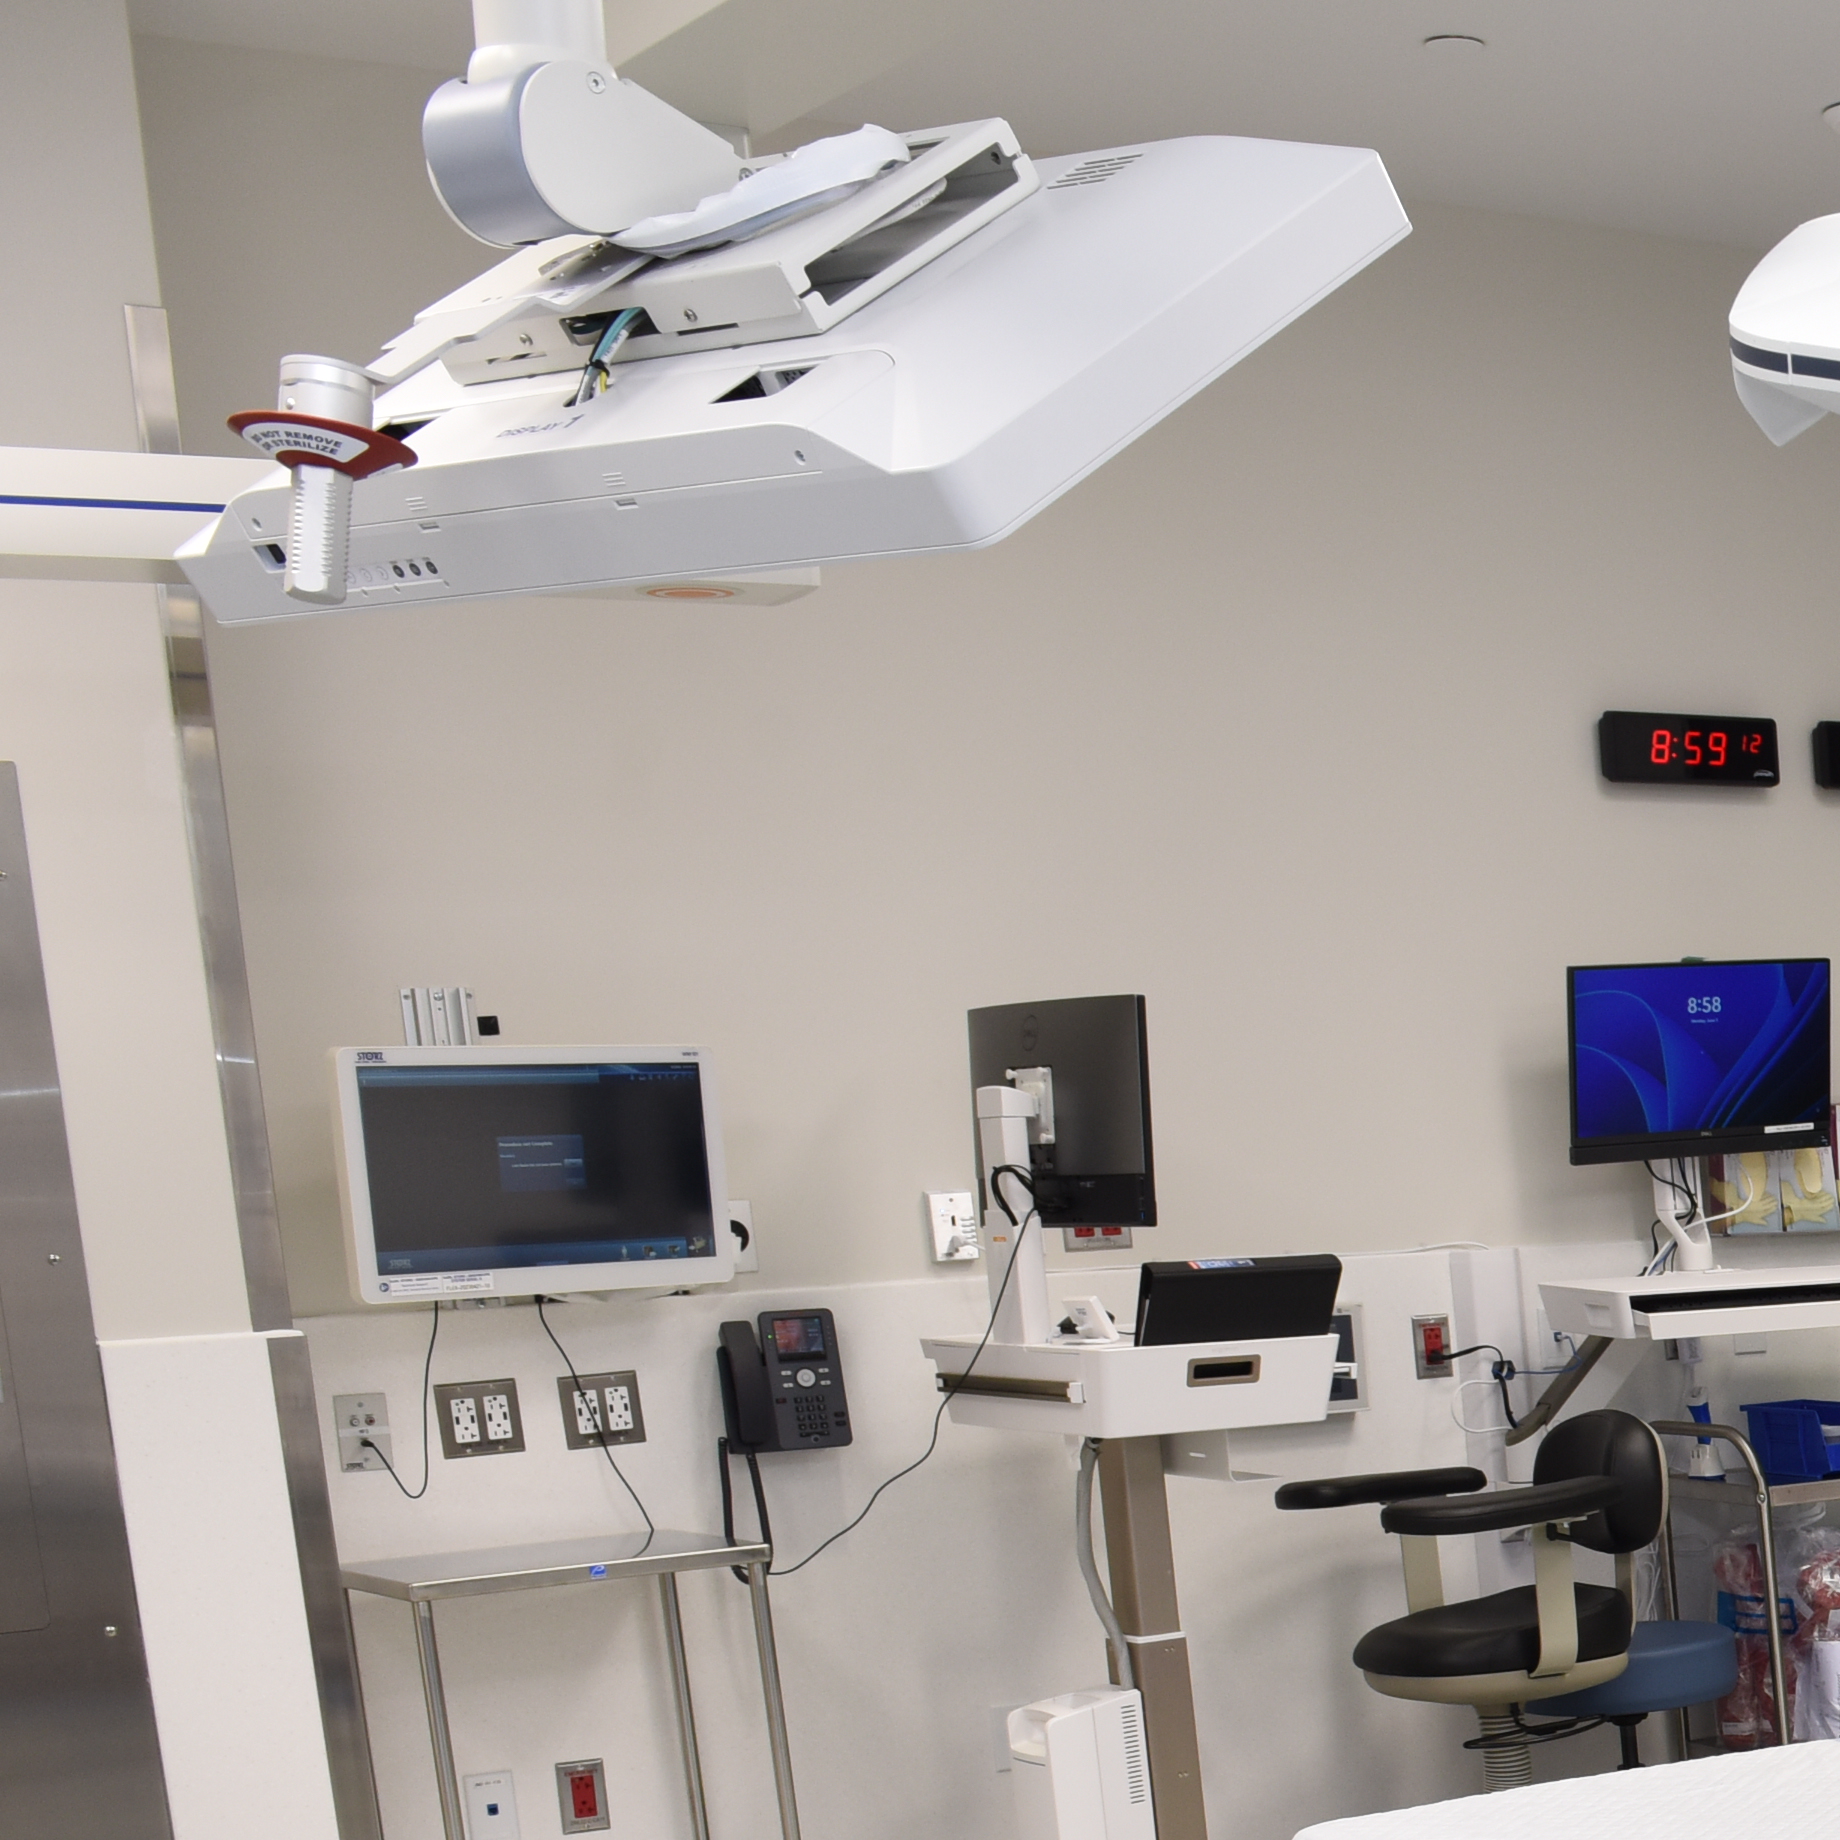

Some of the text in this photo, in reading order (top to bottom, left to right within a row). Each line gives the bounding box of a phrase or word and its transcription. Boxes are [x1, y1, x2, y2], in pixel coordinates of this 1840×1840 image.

[260, 430, 282, 440] NOT
[284, 430, 343, 449] REMOVE
[271, 438, 339, 456] STERILIZE
[1651, 730, 1762, 767] 8:59 12
[1687, 996, 1722, 1015] 8:58
[357, 1051, 384, 1062] STORZ
